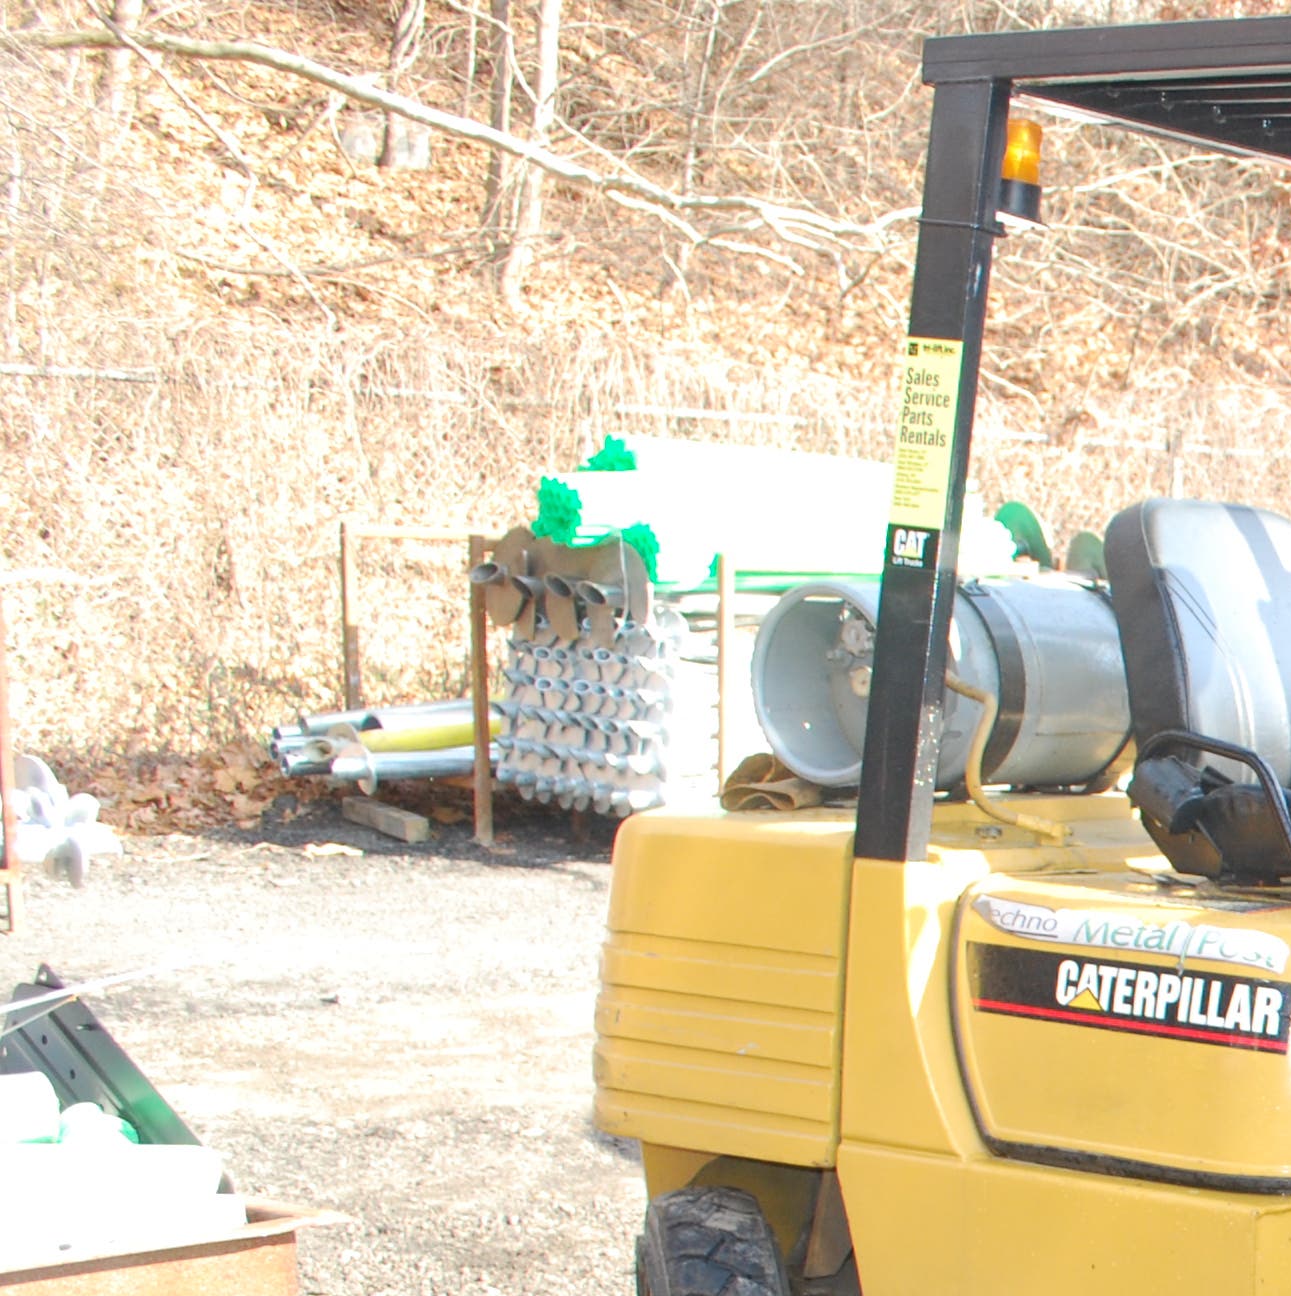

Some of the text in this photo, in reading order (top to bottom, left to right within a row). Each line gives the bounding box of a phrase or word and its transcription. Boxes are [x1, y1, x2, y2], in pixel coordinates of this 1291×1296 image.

[906, 367, 939, 386] Sales
[904, 386, 950, 408] Service
[902, 405, 933, 426] Parts
[900, 425, 946, 447] Rentals
[893, 528, 929, 559] CAT
[990, 908, 1058, 934] echno
[1073, 917, 1179, 951] Metal
[1054, 959, 1283, 1037] CATERPILLAR
